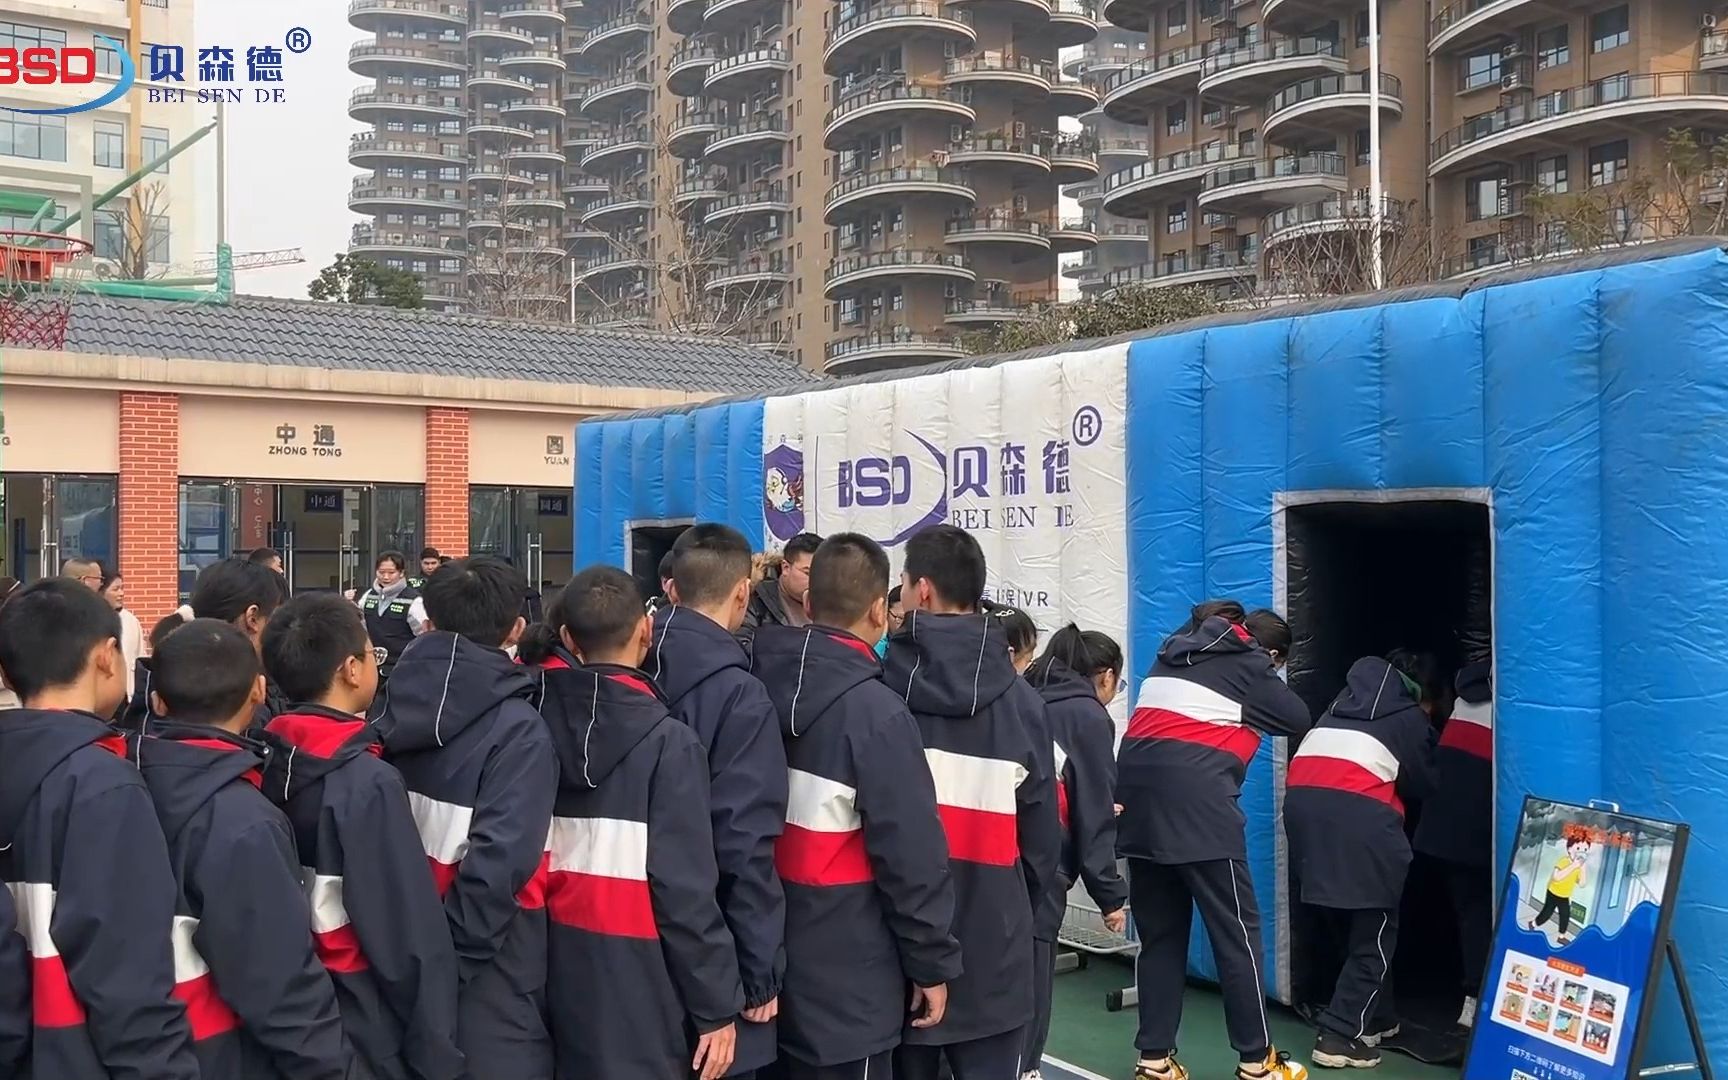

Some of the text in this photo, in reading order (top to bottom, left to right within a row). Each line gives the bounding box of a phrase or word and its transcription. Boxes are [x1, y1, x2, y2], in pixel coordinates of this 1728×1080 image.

[276, 422, 336, 447] 中通
[268, 445, 342, 458] ZHONG TONG
[952, 509, 993, 530] BEI
[1023, 590, 1049, 607] VR
